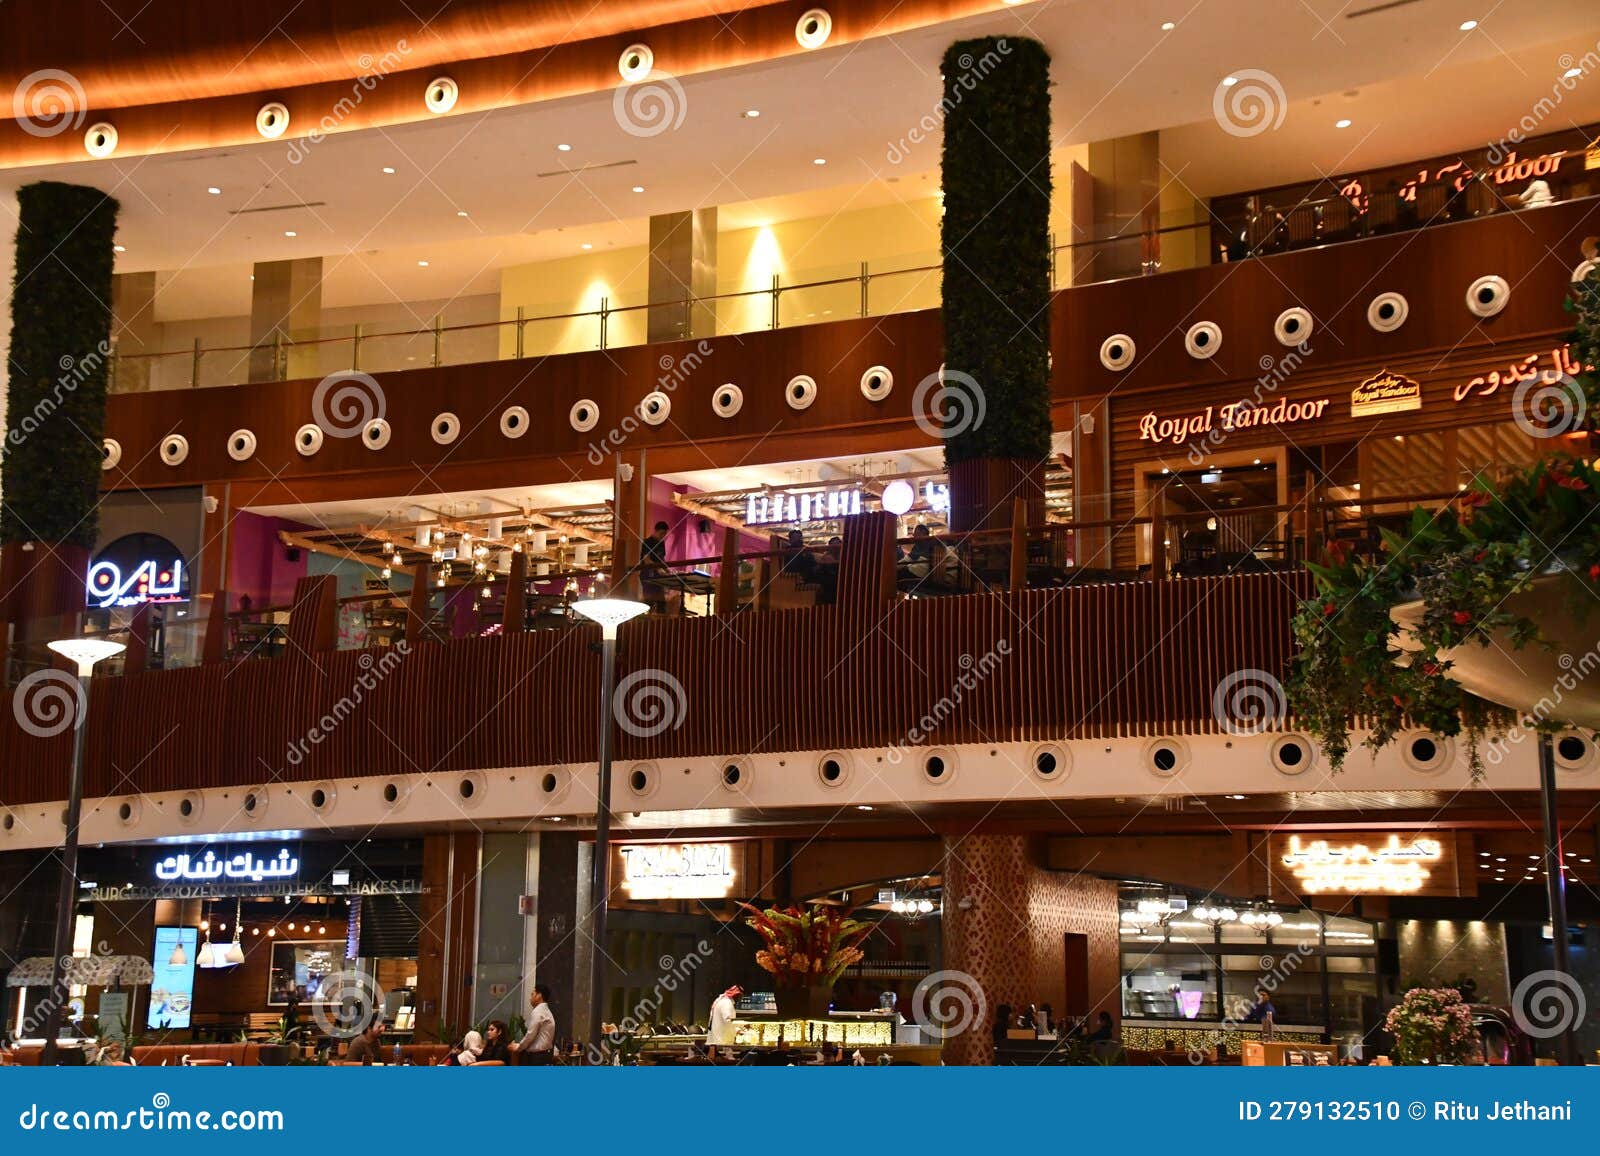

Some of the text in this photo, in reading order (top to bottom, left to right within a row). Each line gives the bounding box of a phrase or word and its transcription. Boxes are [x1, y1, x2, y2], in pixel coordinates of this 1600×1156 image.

[1139, 397, 1329, 444] Royal Tandoor
[155, 848, 299, 882] شيك شاك
